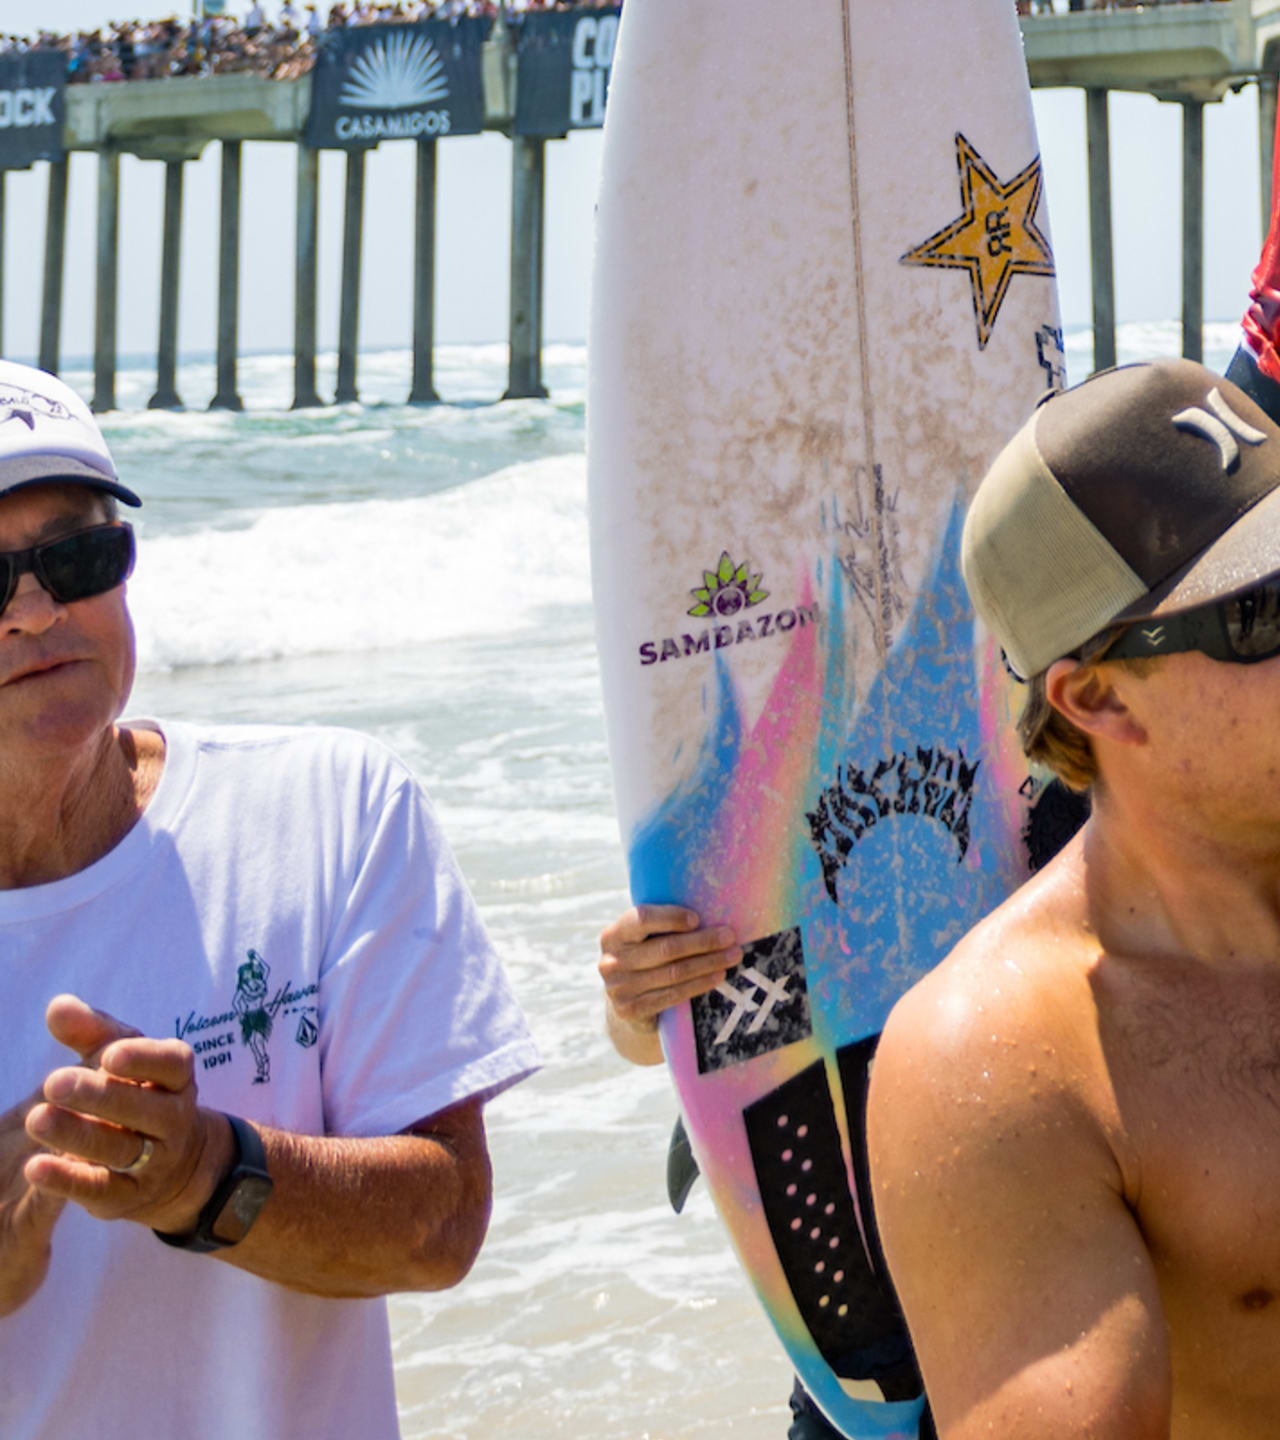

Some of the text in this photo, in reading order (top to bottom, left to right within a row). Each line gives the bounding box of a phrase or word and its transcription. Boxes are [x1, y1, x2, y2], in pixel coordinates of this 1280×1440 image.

[0, 87, 56, 127] OCK
[335, 109, 450, 140] CASAMIGOS
[639, 601, 820, 666] SAMBAZON
[194, 1032, 235, 1055] SINCE
[203, 1051, 232, 1069] 1991
